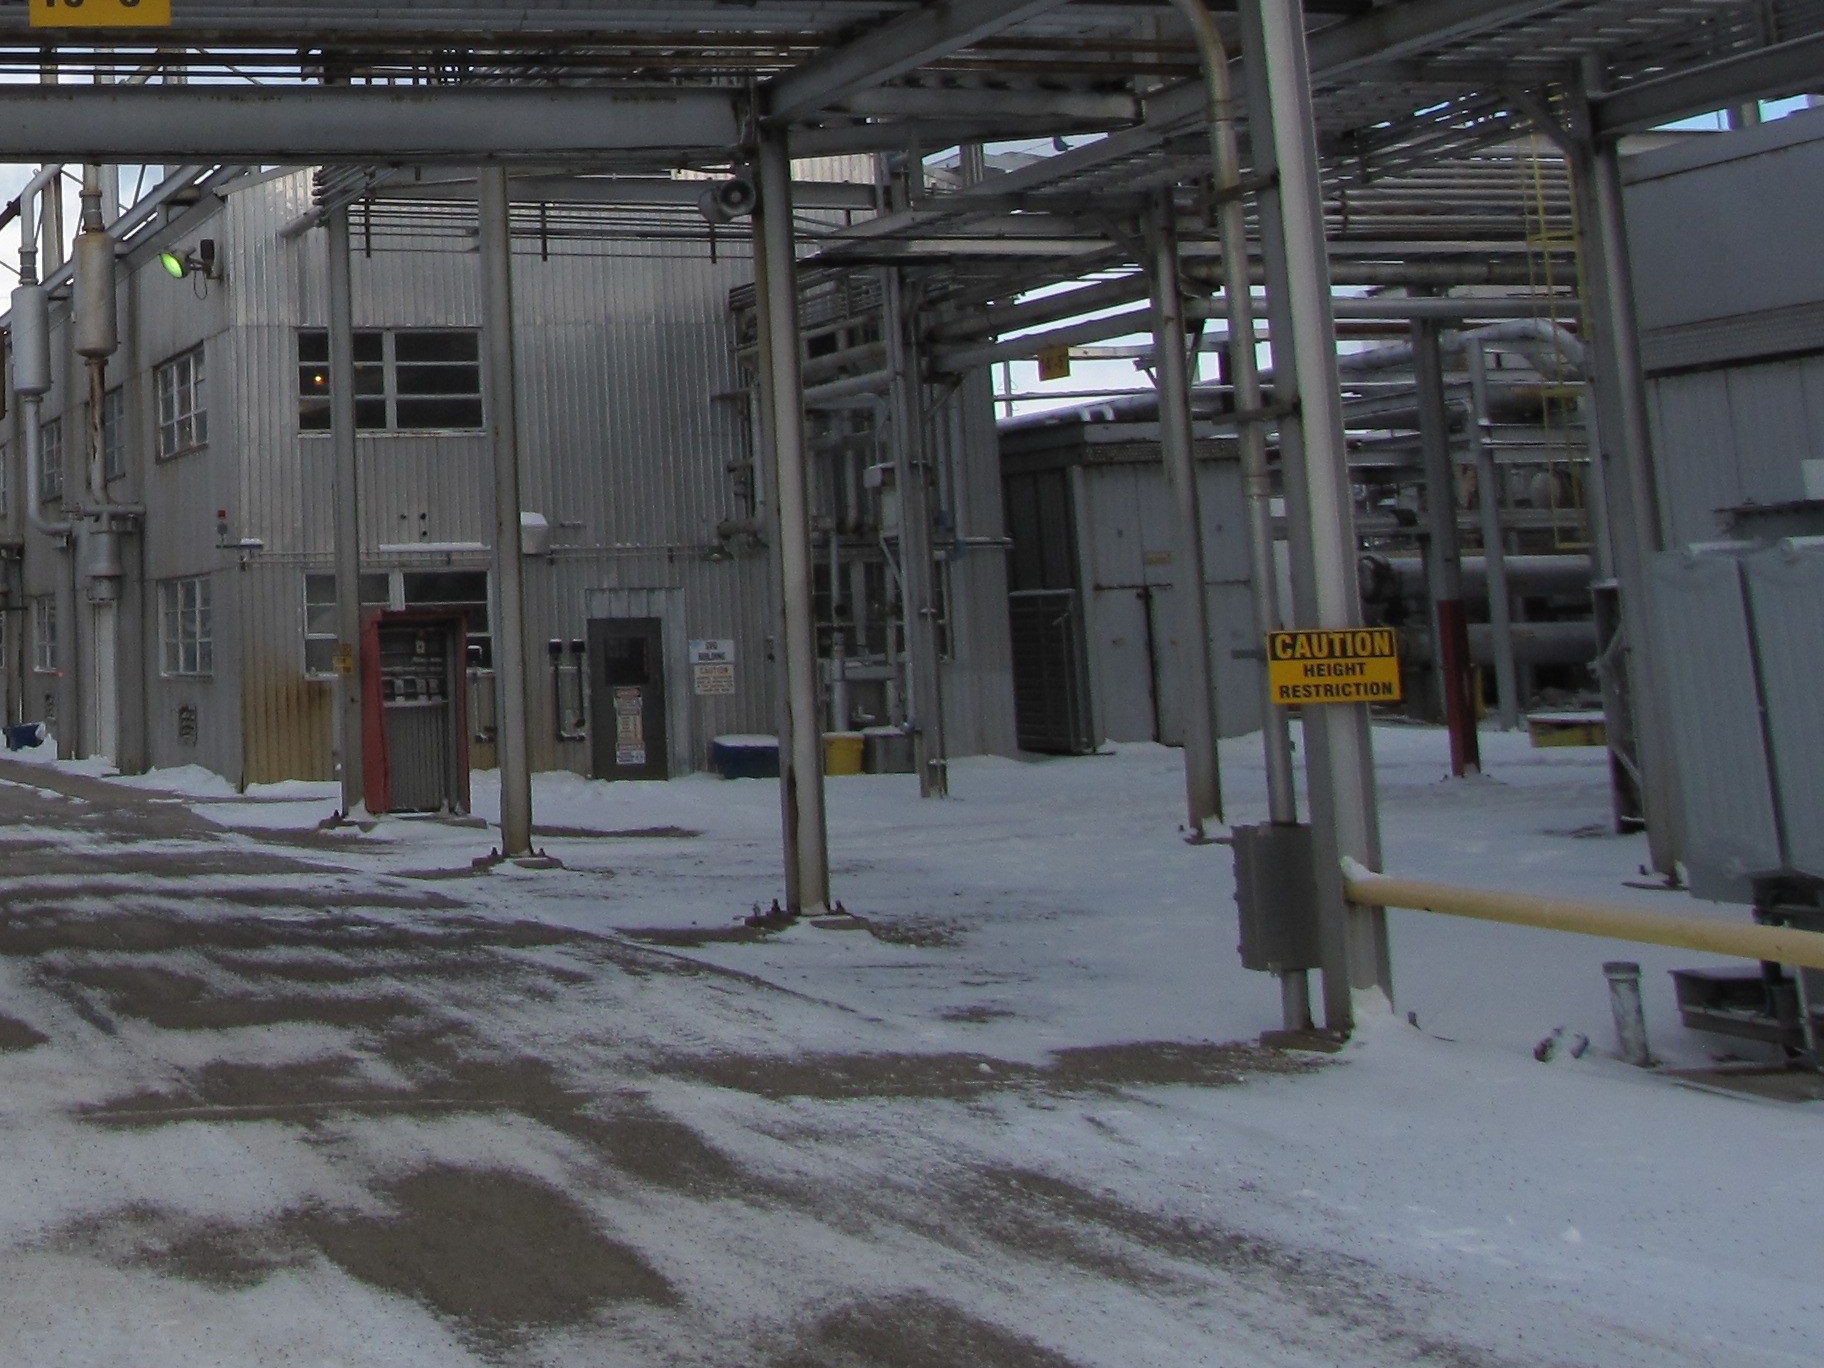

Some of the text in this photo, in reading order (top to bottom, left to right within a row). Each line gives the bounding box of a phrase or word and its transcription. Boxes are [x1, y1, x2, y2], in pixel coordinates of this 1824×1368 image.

[1275, 631, 1391, 659] CAUTION
[1303, 662, 1366, 677] HEIGHT
[1279, 682, 1393, 699] RESTRICTION
